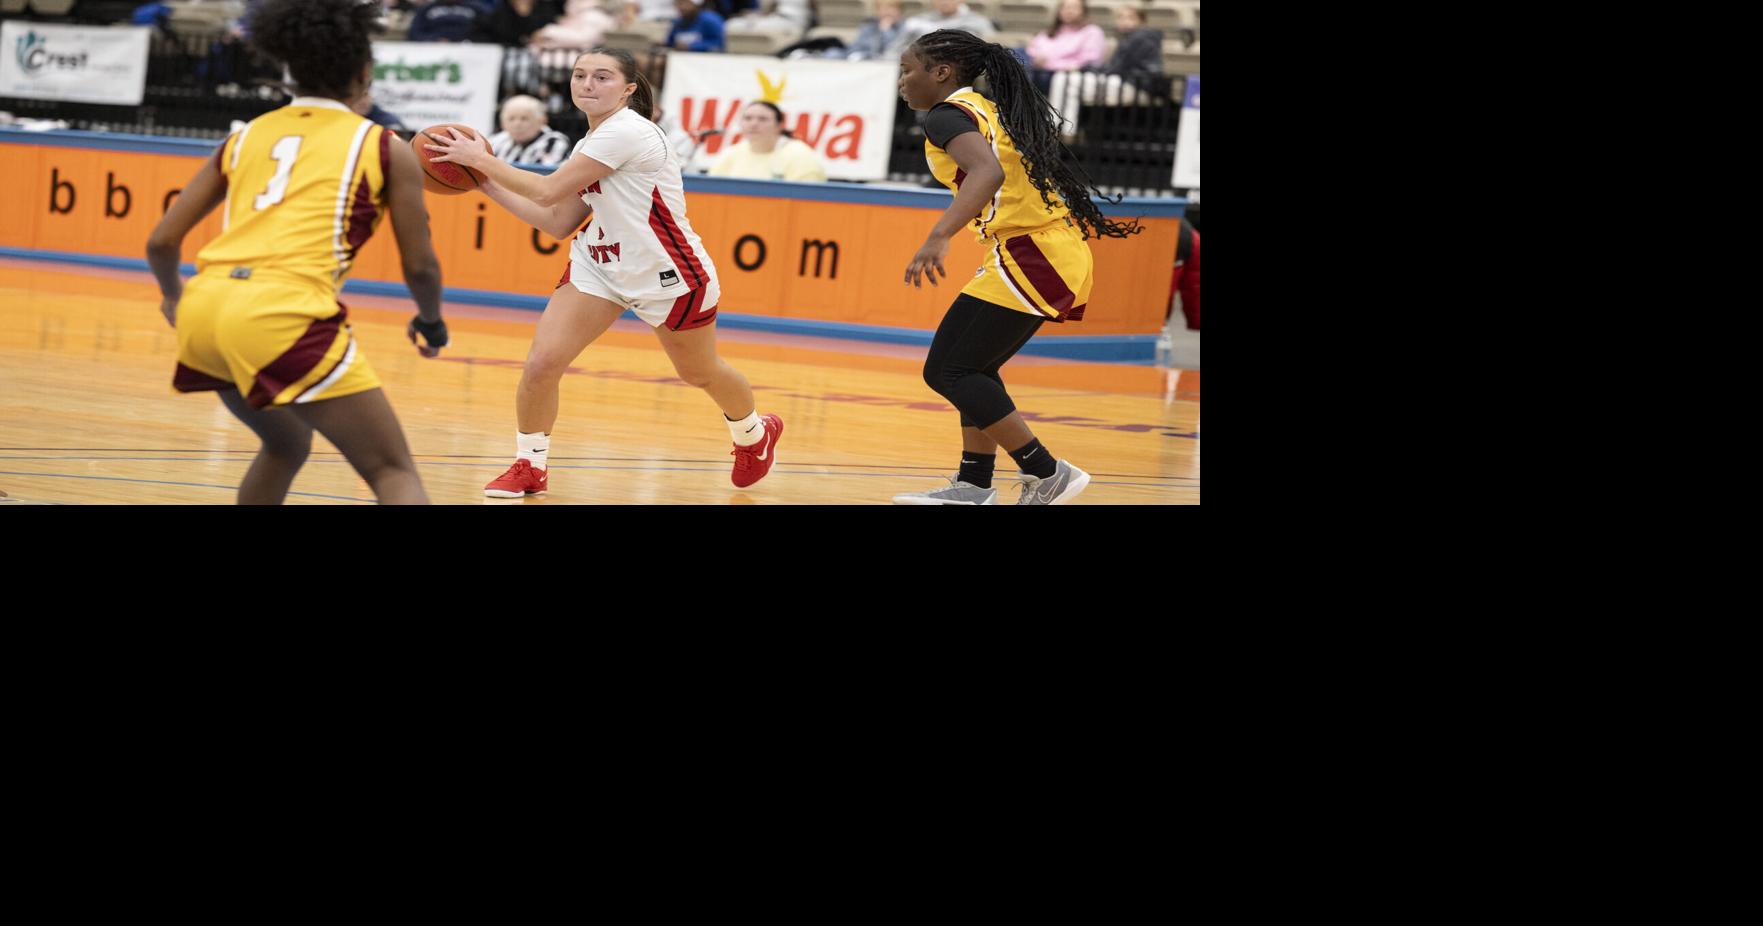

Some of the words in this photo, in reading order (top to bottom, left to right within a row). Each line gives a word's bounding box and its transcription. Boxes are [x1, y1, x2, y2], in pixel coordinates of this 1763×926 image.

[27, 48, 88, 70] Crest
[680, 98, 864, 159] Wwa
[253, 134, 304, 211] 1
